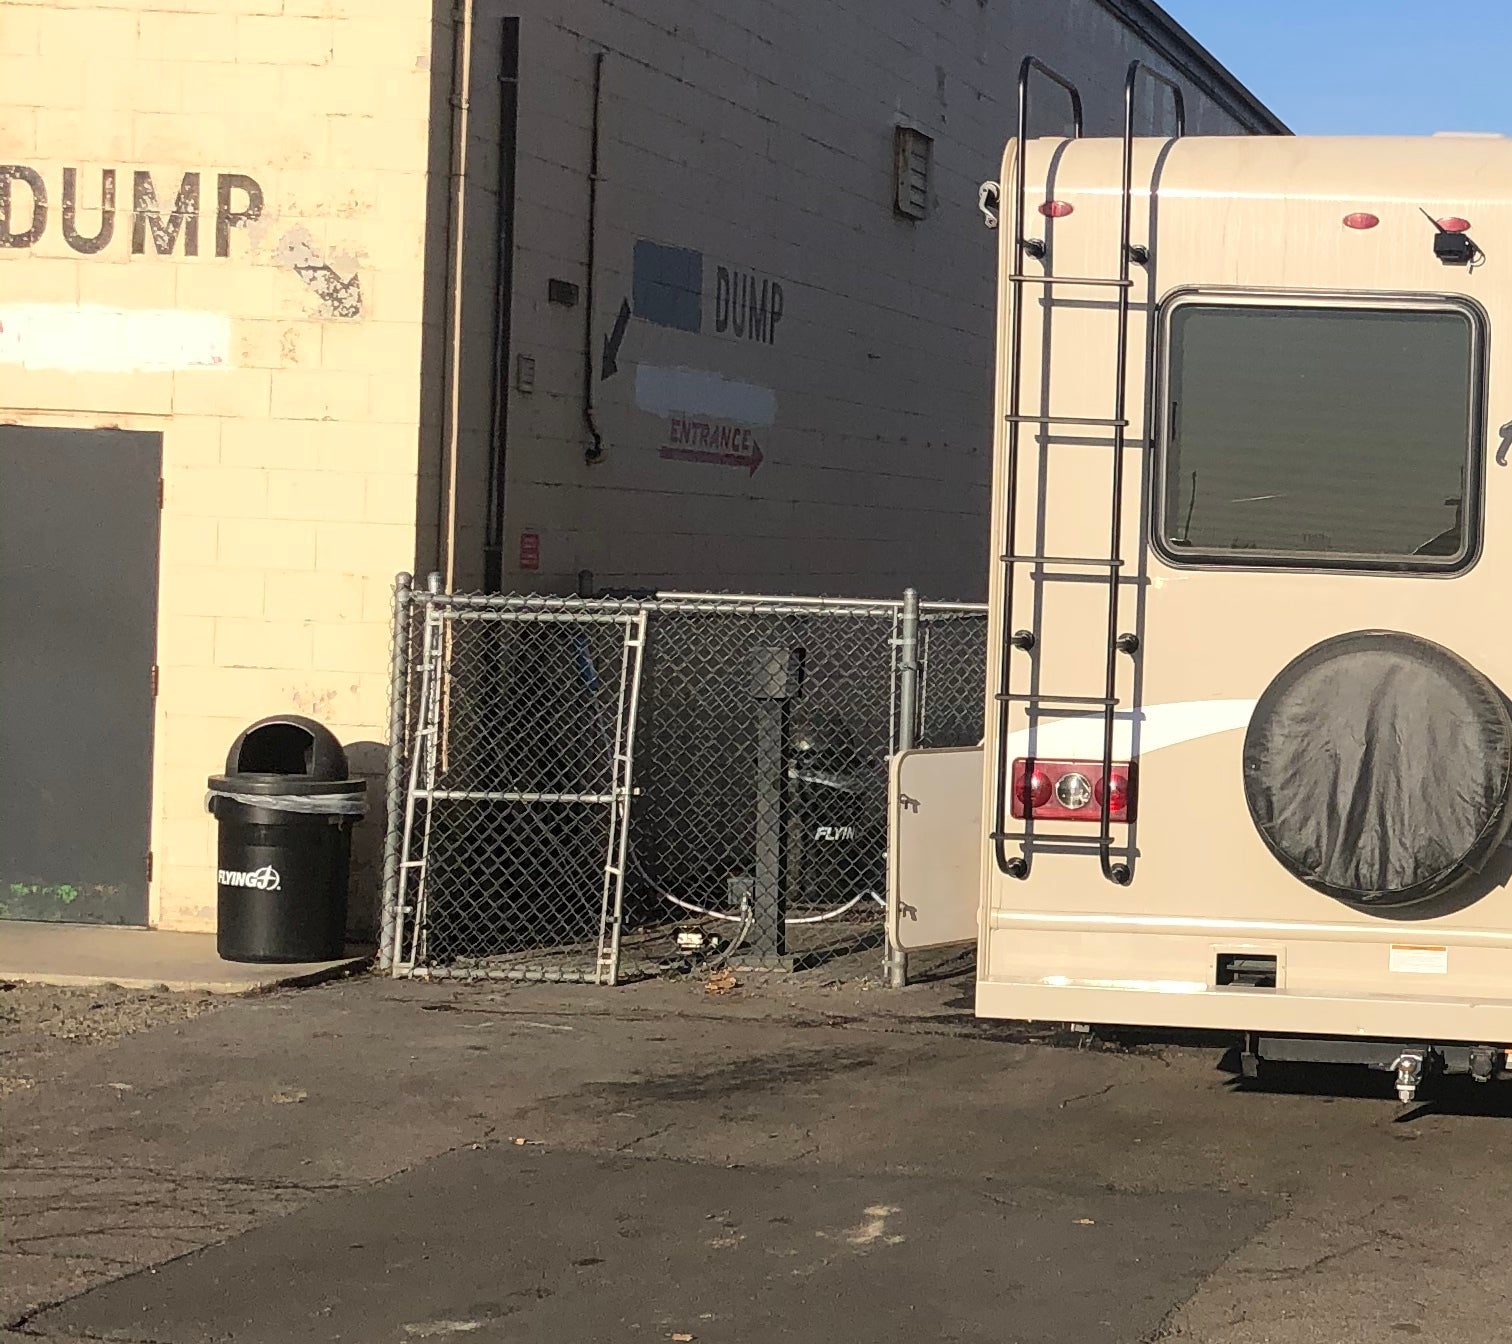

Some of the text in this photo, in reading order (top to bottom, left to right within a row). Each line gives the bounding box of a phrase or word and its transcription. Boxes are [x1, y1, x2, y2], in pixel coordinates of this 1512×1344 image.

[0, 164, 264, 258] DUMP
[715, 265, 784, 345] DUMP
[669, 418, 752, 453] ENTRANCE
